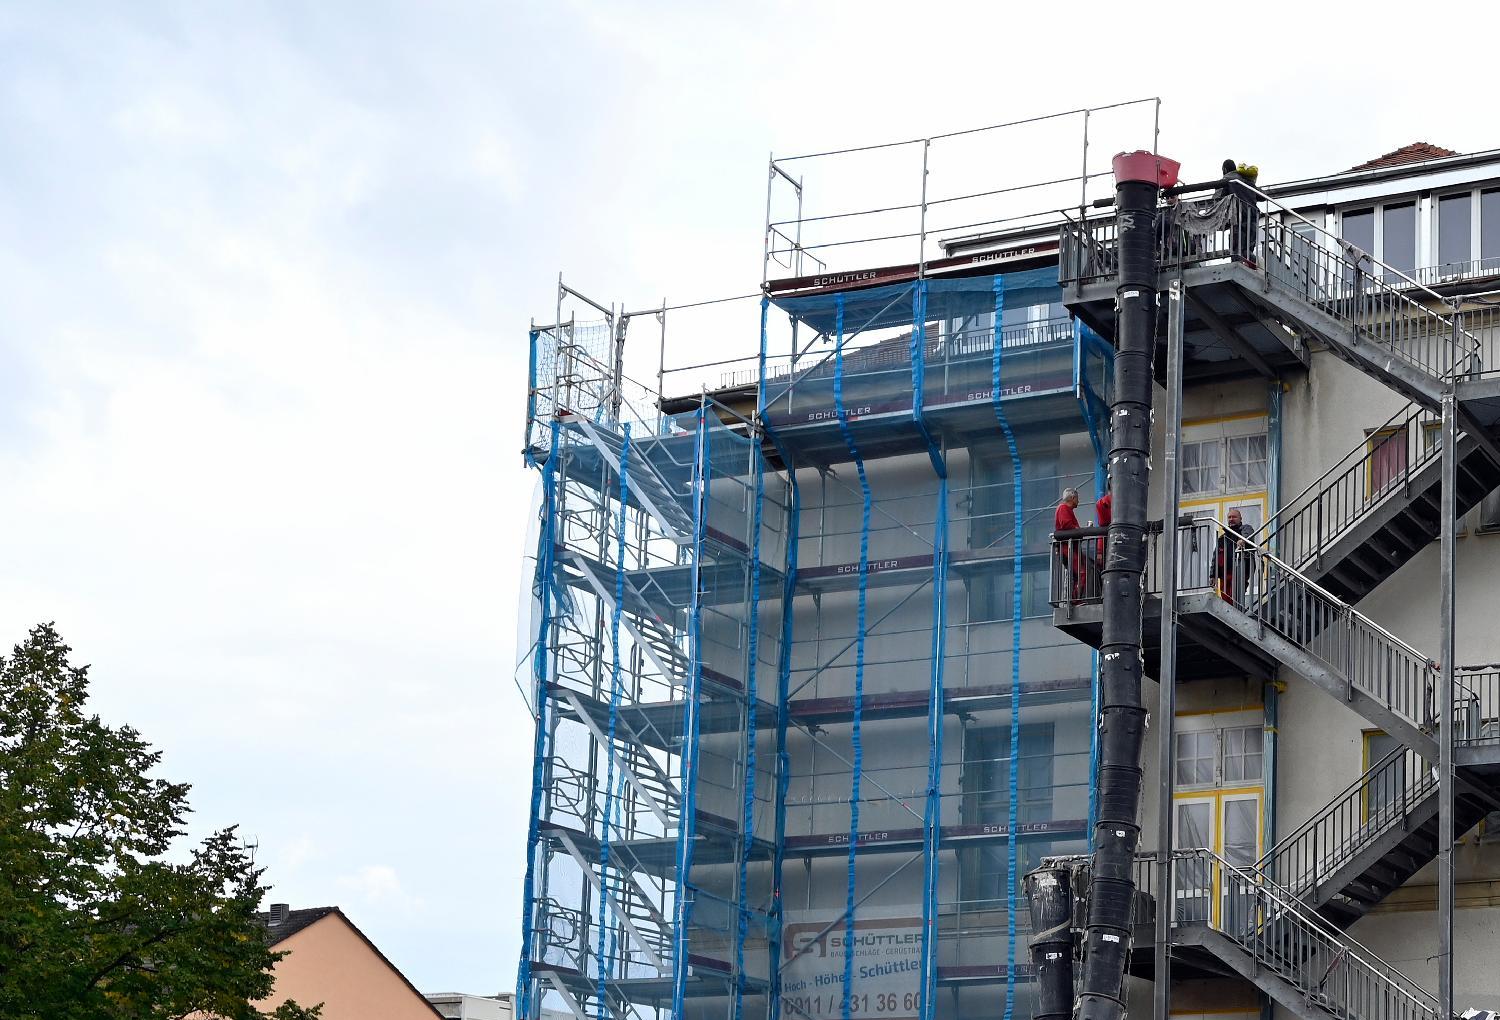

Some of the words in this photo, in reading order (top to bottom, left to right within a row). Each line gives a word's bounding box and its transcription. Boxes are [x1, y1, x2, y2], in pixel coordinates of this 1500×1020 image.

[967, 384, 1032, 400] SCHTTLER
[837, 560, 898, 573] SCHTTLER
[983, 824, 1048, 832] SCHTTLER
[828, 833, 888, 842] SCHTTLER
[784, 980, 806, 992] Hoch
[815, 973, 848, 987] Höhe
[876, 992, 897, 1012] 36
